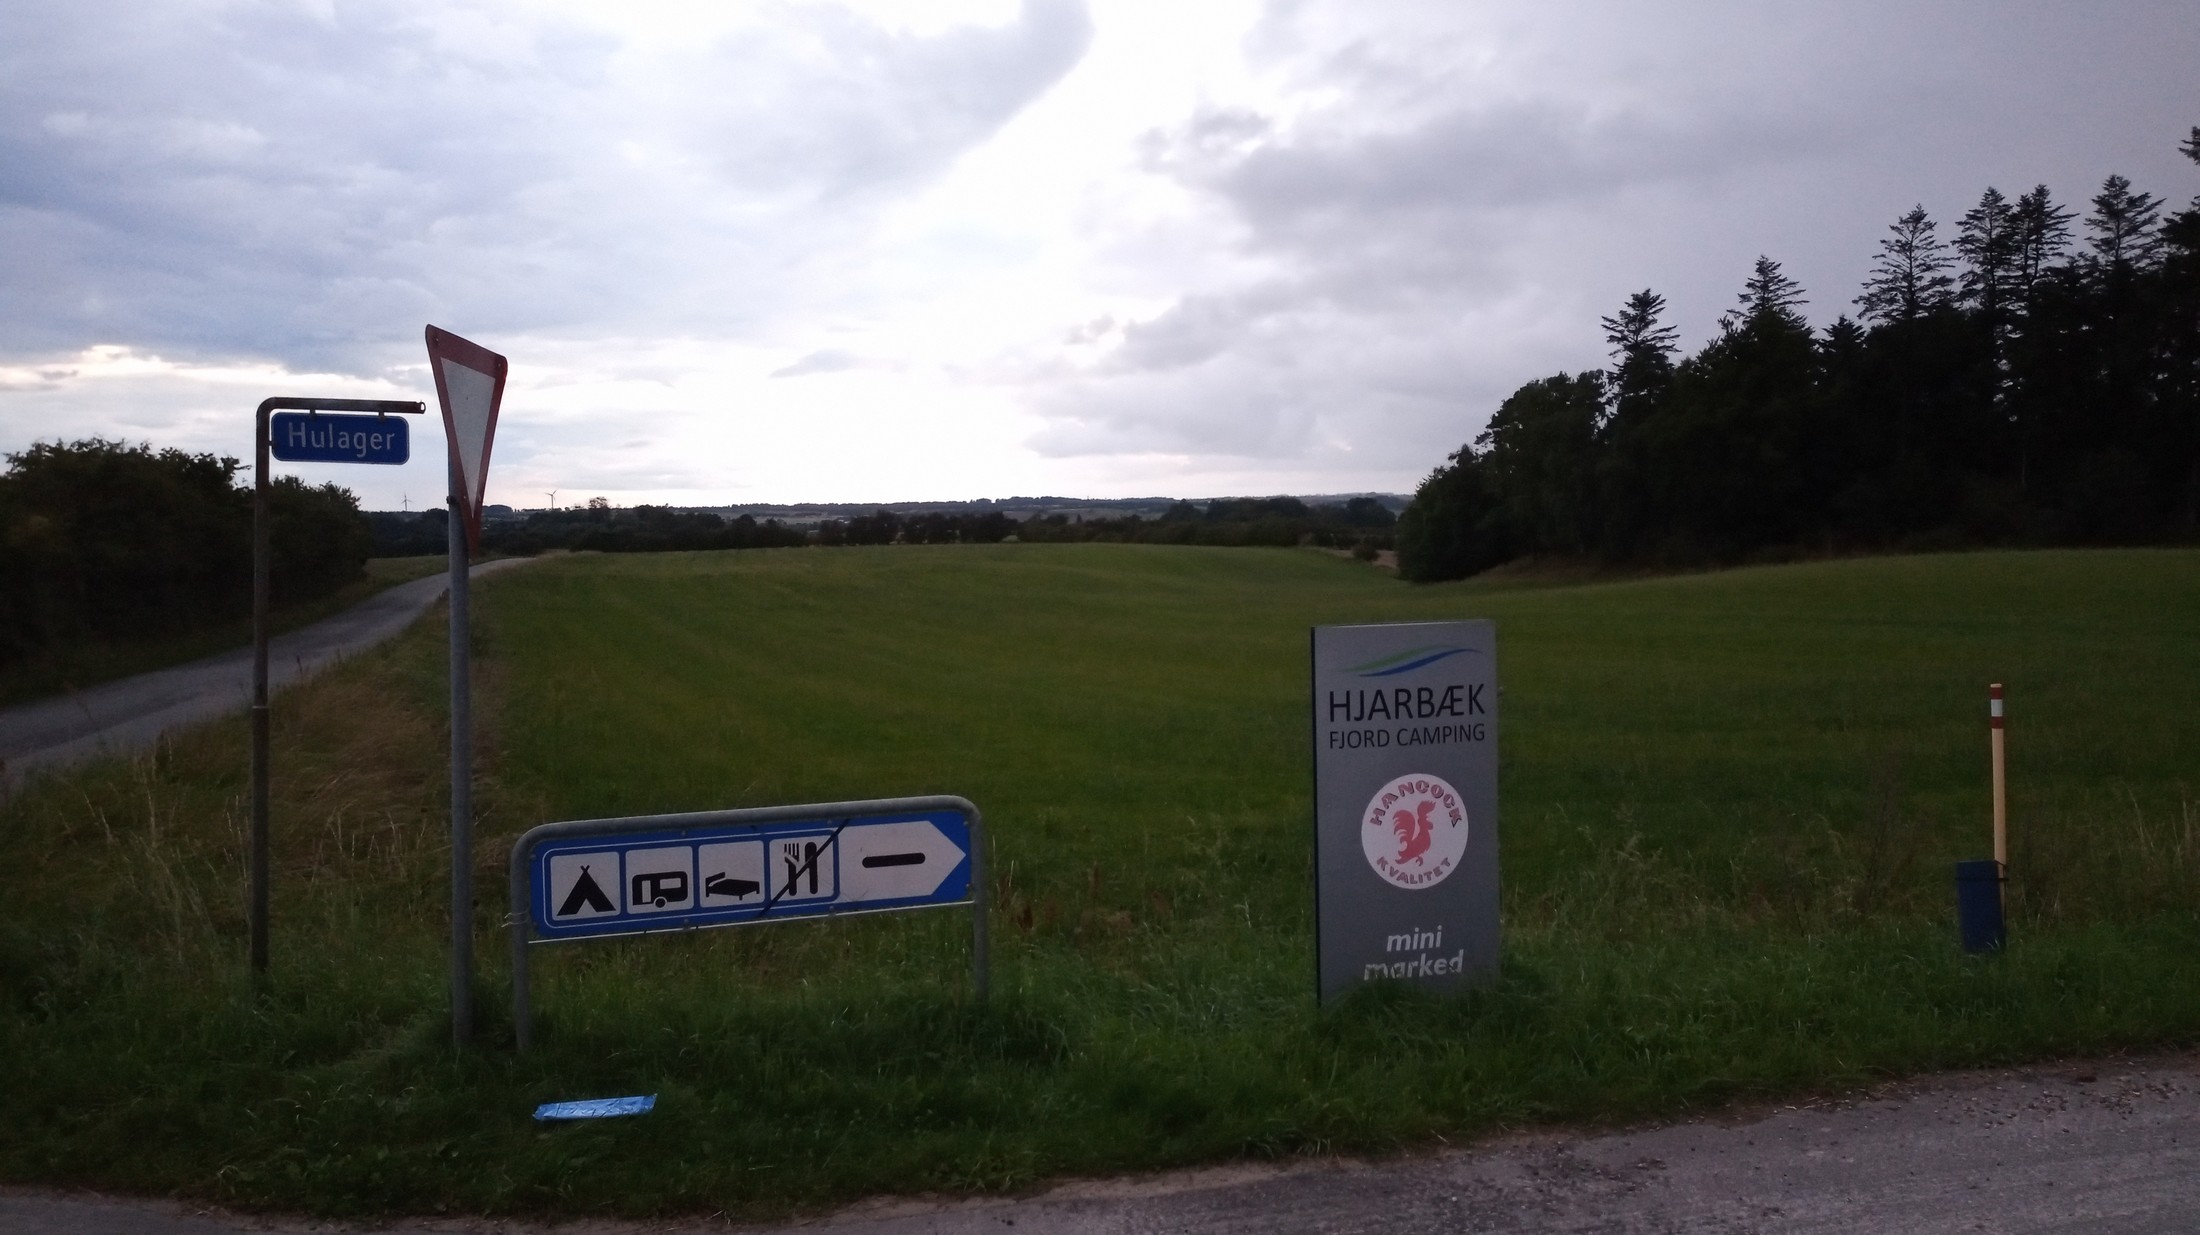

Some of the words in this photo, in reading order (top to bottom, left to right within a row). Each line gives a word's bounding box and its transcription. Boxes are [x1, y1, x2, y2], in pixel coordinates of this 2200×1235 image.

[288, 421, 396, 458] Hulager
[1329, 683, 1486, 722] HJARBÆK
[1329, 729, 1390, 749] FJORD
[1396, 723, 1486, 747] CAMPING
[1369, 779, 1463, 828] HANCOCK
[1375, 856, 1452, 885] KVALITET
[1386, 925, 1443, 952] mini
[1363, 949, 1465, 981] marked
